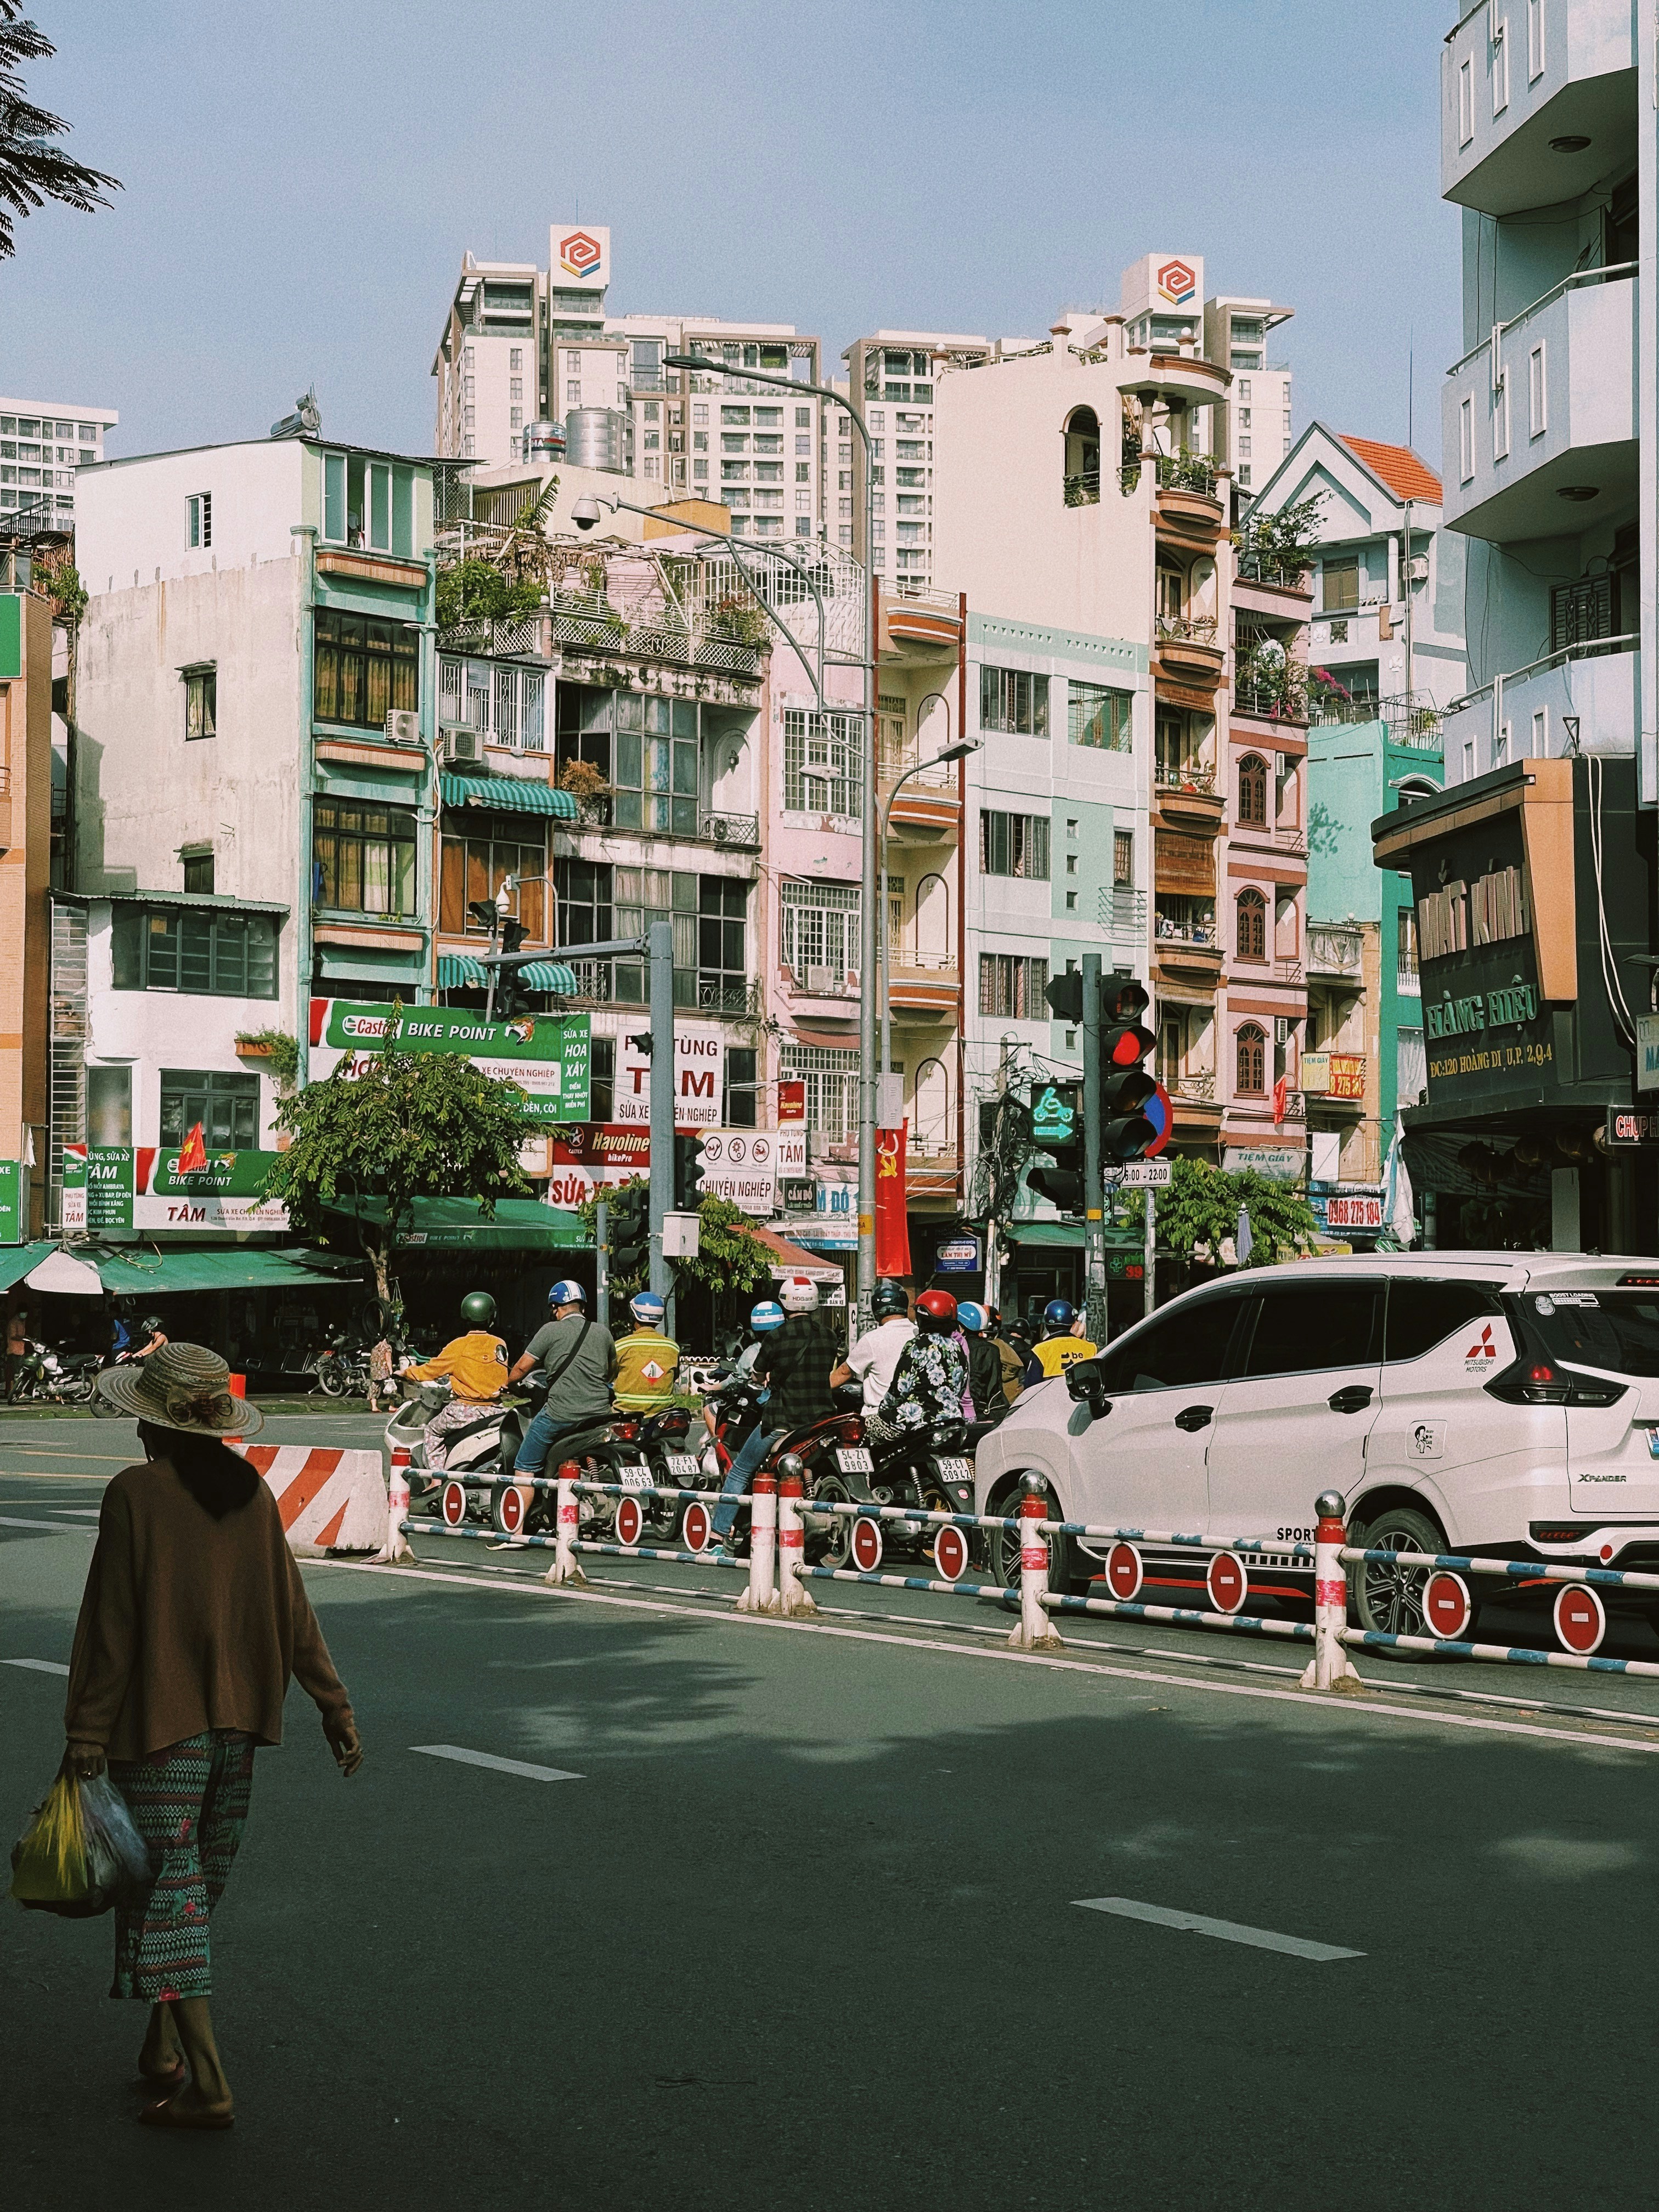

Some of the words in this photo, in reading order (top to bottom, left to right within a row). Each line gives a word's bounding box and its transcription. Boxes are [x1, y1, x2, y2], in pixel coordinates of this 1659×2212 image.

[1426, 990, 1485, 1040] HÀNG
[1487, 974, 1537, 1031] HIỆU
[407, 1023, 444, 1038] BIKE
[449, 1025, 496, 1041] POINT
[563, 1028, 577, 1039] SỬA
[579, 1029, 588, 1038] XE
[565, 1043, 587, 1058] HOA
[565, 1060, 587, 1077] XÂY
[1459, 1048, 1490, 1073] HOÀNG
[482, 1066, 492, 1075] XE
[493, 1066, 524, 1076] CHUYÊN
[527, 1069, 555, 1079] NGHIỆP
[619, 1099, 636, 1119] SỬA
[639, 1104, 650, 1119] XE
[687, 1104, 717, 1125] NGHIỆP
[1616, 1115, 1649, 1141] CHỤP
[592, 1132, 650, 1152] Havoline
[106, 1150, 120, 1161] SỬA
[607, 1153, 633, 1163] bikePro
[779, 1141, 803, 1163] TÂM
[1238, 1152, 1265, 1162] TIỆM
[168, 1175, 194, 1186] BIKE
[198, 1176, 232, 1186] POINT
[1149, 1168, 1167, 1181] 22:00
[552, 1172, 586, 1205] SỬA
[699, 1177, 735, 1197] CHUYÊN
[738, 1178, 771, 1201] NGHIỆP
[65, 1210, 84, 1223] TÂM
[167, 1204, 206, 1222] TÂM
[1329, 1199, 1348, 1224] 0968
[1351, 1200, 1363, 1224] 275
[1125, 1265, 1143, 1278] 39
[844, 1460, 869, 1471] 9803
[1577, 1474, 1627, 1482] XPANDER
[1277, 1527, 1317, 1542] SPORT
